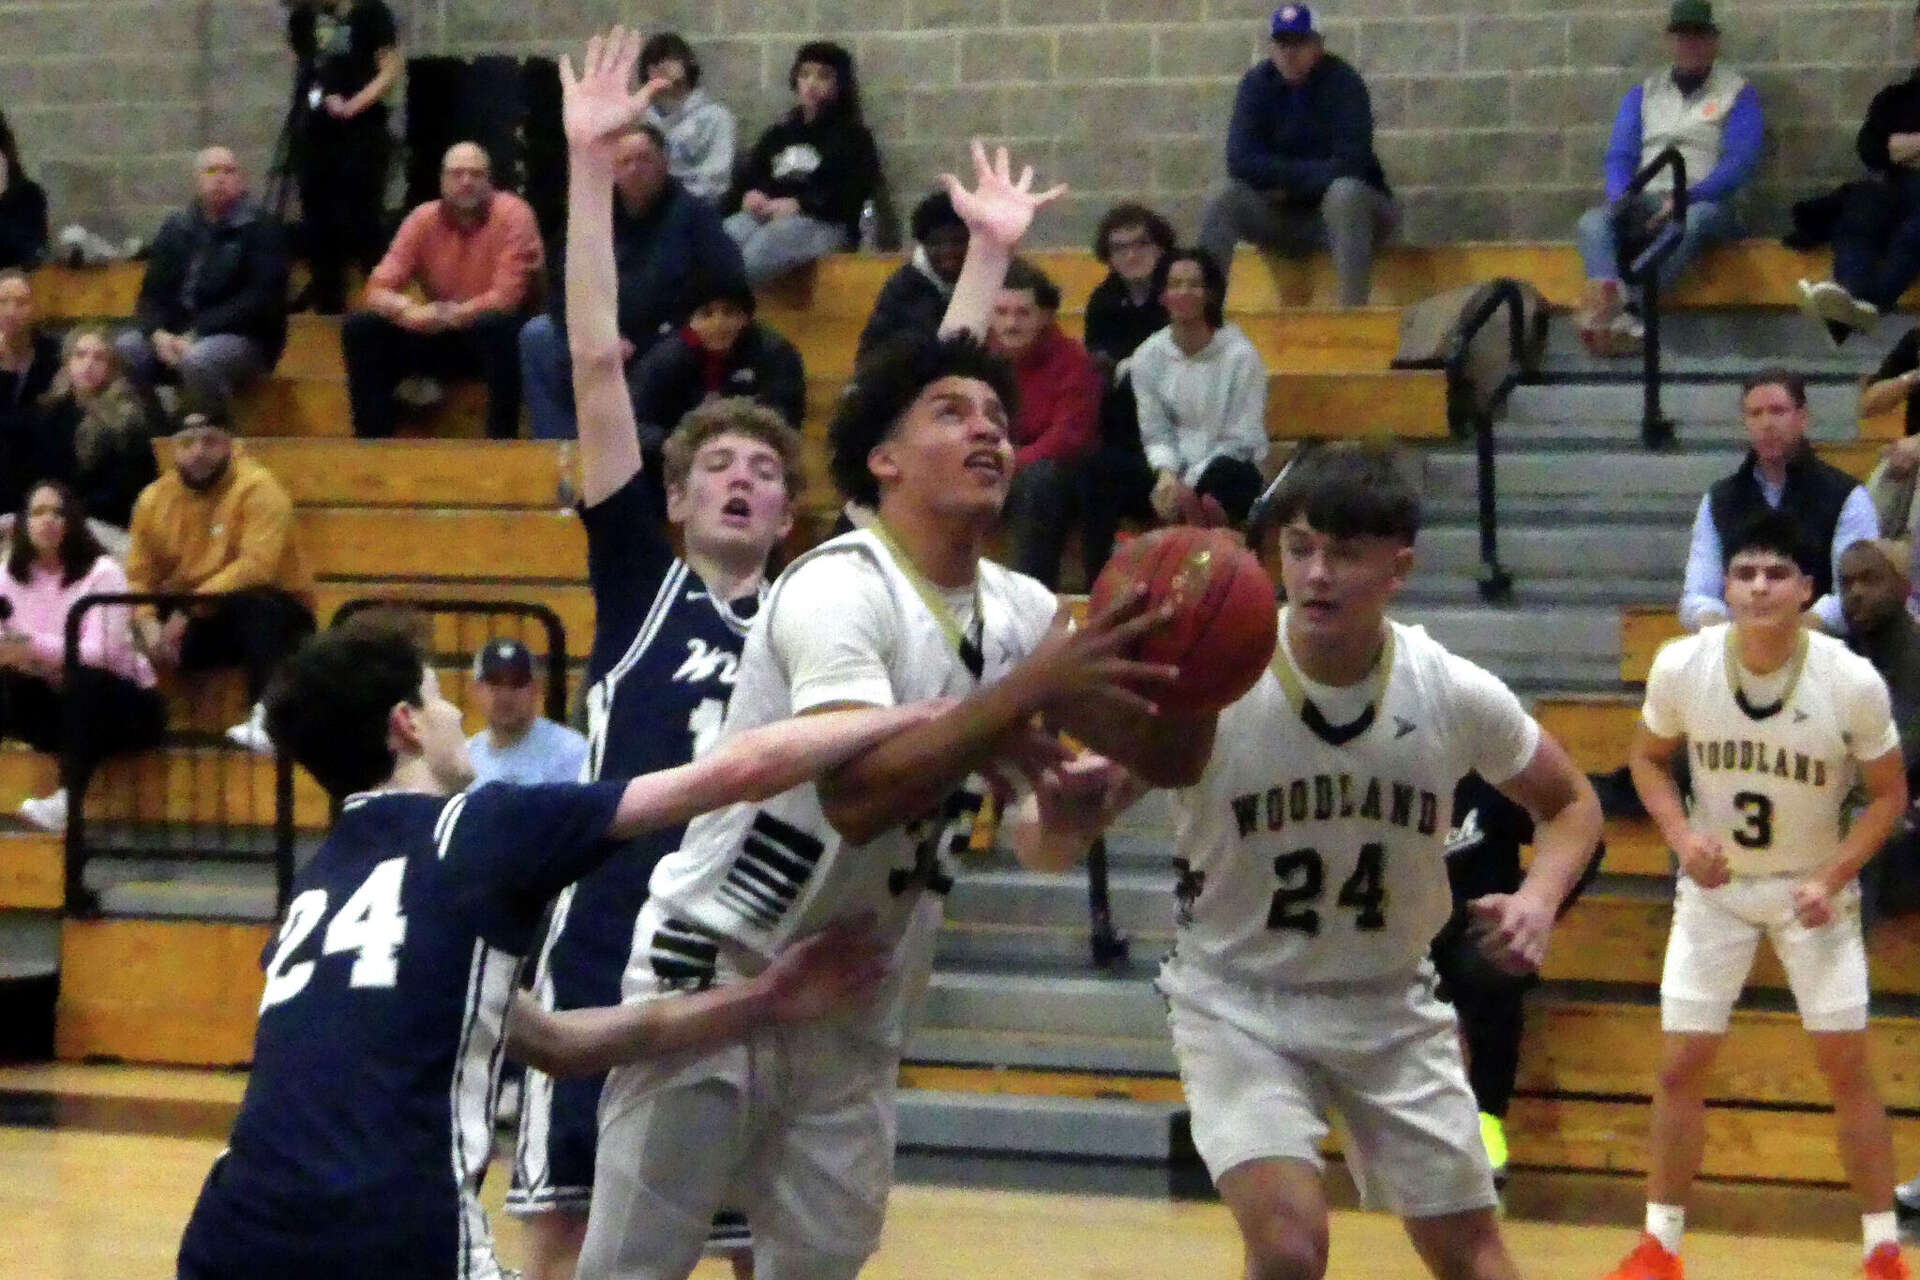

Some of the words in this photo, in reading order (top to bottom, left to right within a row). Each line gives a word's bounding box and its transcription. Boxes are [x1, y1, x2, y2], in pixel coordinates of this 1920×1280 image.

[1693, 739, 1827, 786] WOODLAND
[1231, 773, 1438, 839] WOODLAND
[1733, 789, 1773, 848] 3
[1266, 842, 1386, 937] 24
[258, 855, 408, 1017] 24
